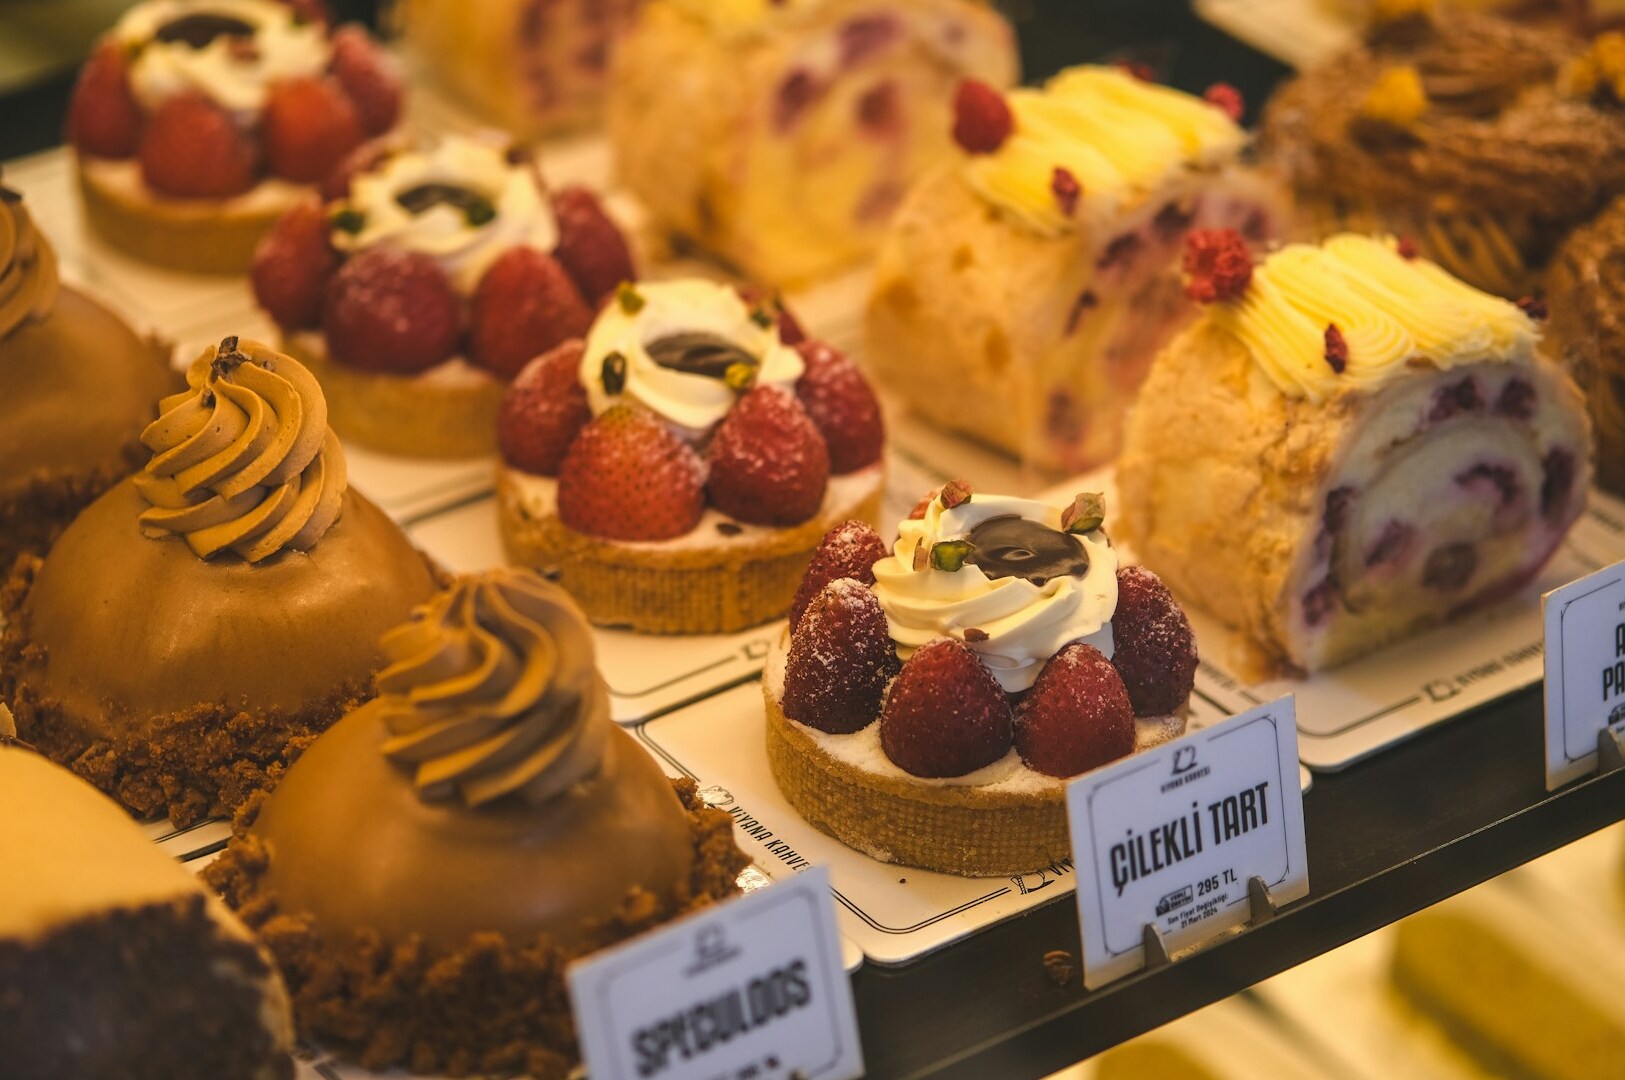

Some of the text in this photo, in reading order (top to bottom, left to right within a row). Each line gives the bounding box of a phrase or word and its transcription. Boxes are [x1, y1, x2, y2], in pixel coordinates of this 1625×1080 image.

[1110, 781, 1269, 898] ÇİLEKLİ TART
[764, 839, 814, 874] KAHVE
[1197, 868, 1238, 897] 295 TL
[1180, 907, 1195, 919] Fiyat
[1188, 914, 1202, 925] Mart
[1202, 906, 1218, 919] 2024
